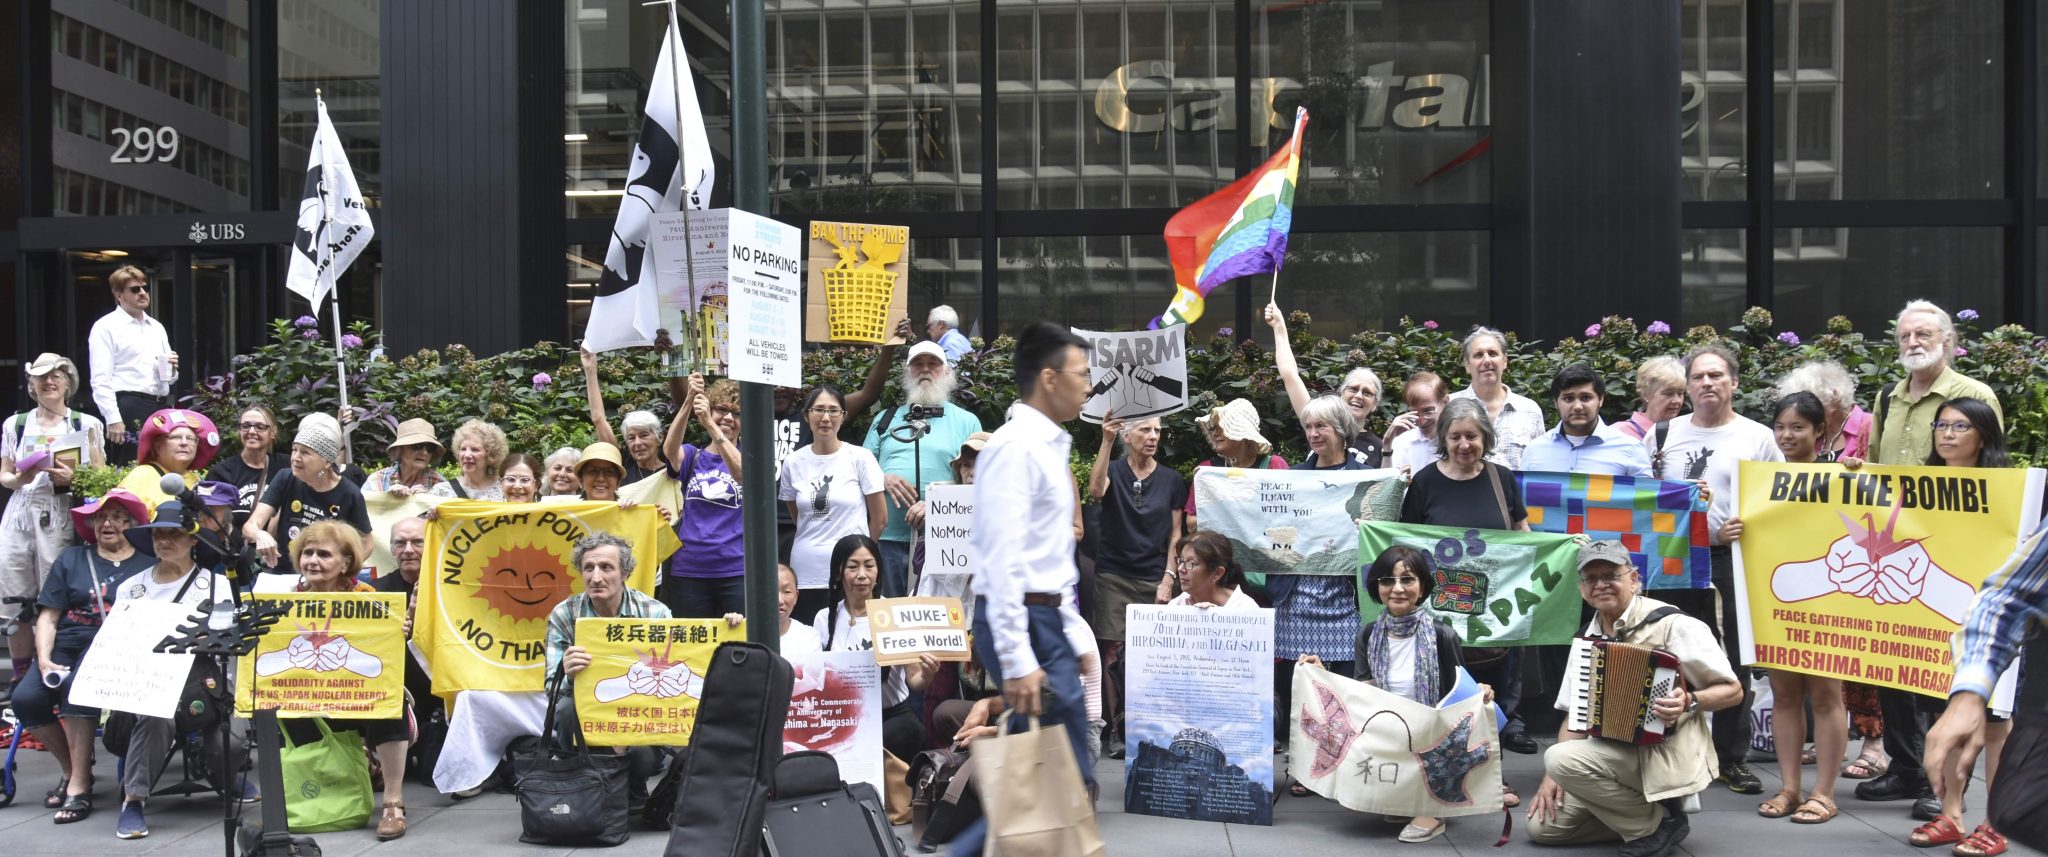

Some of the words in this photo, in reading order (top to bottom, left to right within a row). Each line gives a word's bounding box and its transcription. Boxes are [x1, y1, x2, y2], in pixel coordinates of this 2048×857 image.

[110, 126, 179, 164] 299
[210, 223, 245, 240] UBS
[812, 224, 837, 240] BAN
[841, 224, 865, 242] THE
[872, 226, 907, 245] BOMB
[733, 244, 751, 261] NO
[754, 249, 798, 275] PARKING
[746, 348, 760, 356] WILL
[761, 350, 768, 358] BE
[770, 351, 788, 361] TOWED
[749, 339, 759, 347] ALL
[761, 341, 785, 352] VEHICLES
[1088, 331, 1180, 369] ISARM
[1261, 482, 1292, 490] PEACE
[1769, 471, 1832, 504] BAN
[1839, 472, 1893, 507] THE
[1899, 475, 1990, 514] BOMB!
[1261, 505, 1288, 514] WITH
[1293, 508, 1313, 518] YOU
[443, 514, 530, 585] NUCLEAR
[536, 511, 585, 543] POW
[941, 548, 968, 567] No
[294, 600, 326, 618] THE
[331, 600, 390, 620] BOMB!
[900, 609, 947, 622] NUKE-
[1773, 609, 1807, 624] PEACE
[1809, 613, 1873, 632] GATHERING
[1876, 621, 1890, 635] TO
[1892, 623, 1954, 643] COMMEMO
[460, 618, 493, 651] NO
[499, 640, 546, 662] THA
[882, 636, 917, 649] Free
[923, 634, 963, 647] World!
[1132, 635, 1189, 650] HIROSHIMA
[1210, 638, 1267, 653] NAGASAKI
[1785, 628, 1810, 643] THE
[1813, 631, 1867, 652] ATOMIC
[1870, 638, 1940, 664] BOMBINGS
[1755, 643, 1862, 677] HIROSHIMA
[1865, 664, 1894, 682] AND
[1897, 664, 1954, 694] NAGASA
[271, 678, 325, 688] SOLIDARITY
[326, 678, 365, 688] AGAINST
[266, 690, 309, 699] US-JAPAN
[312, 690, 352, 699] NUCLEAR
[354, 691, 387, 700] ENERGY
[616, 706, 663, 719] 被ばく国
[668, 706, 699, 719] 日本
[820, 716, 858, 727] Nagasaki
[583, 721, 692, 734] 日米原子力協定はい
[1354, 756, 1399, 784] 和
